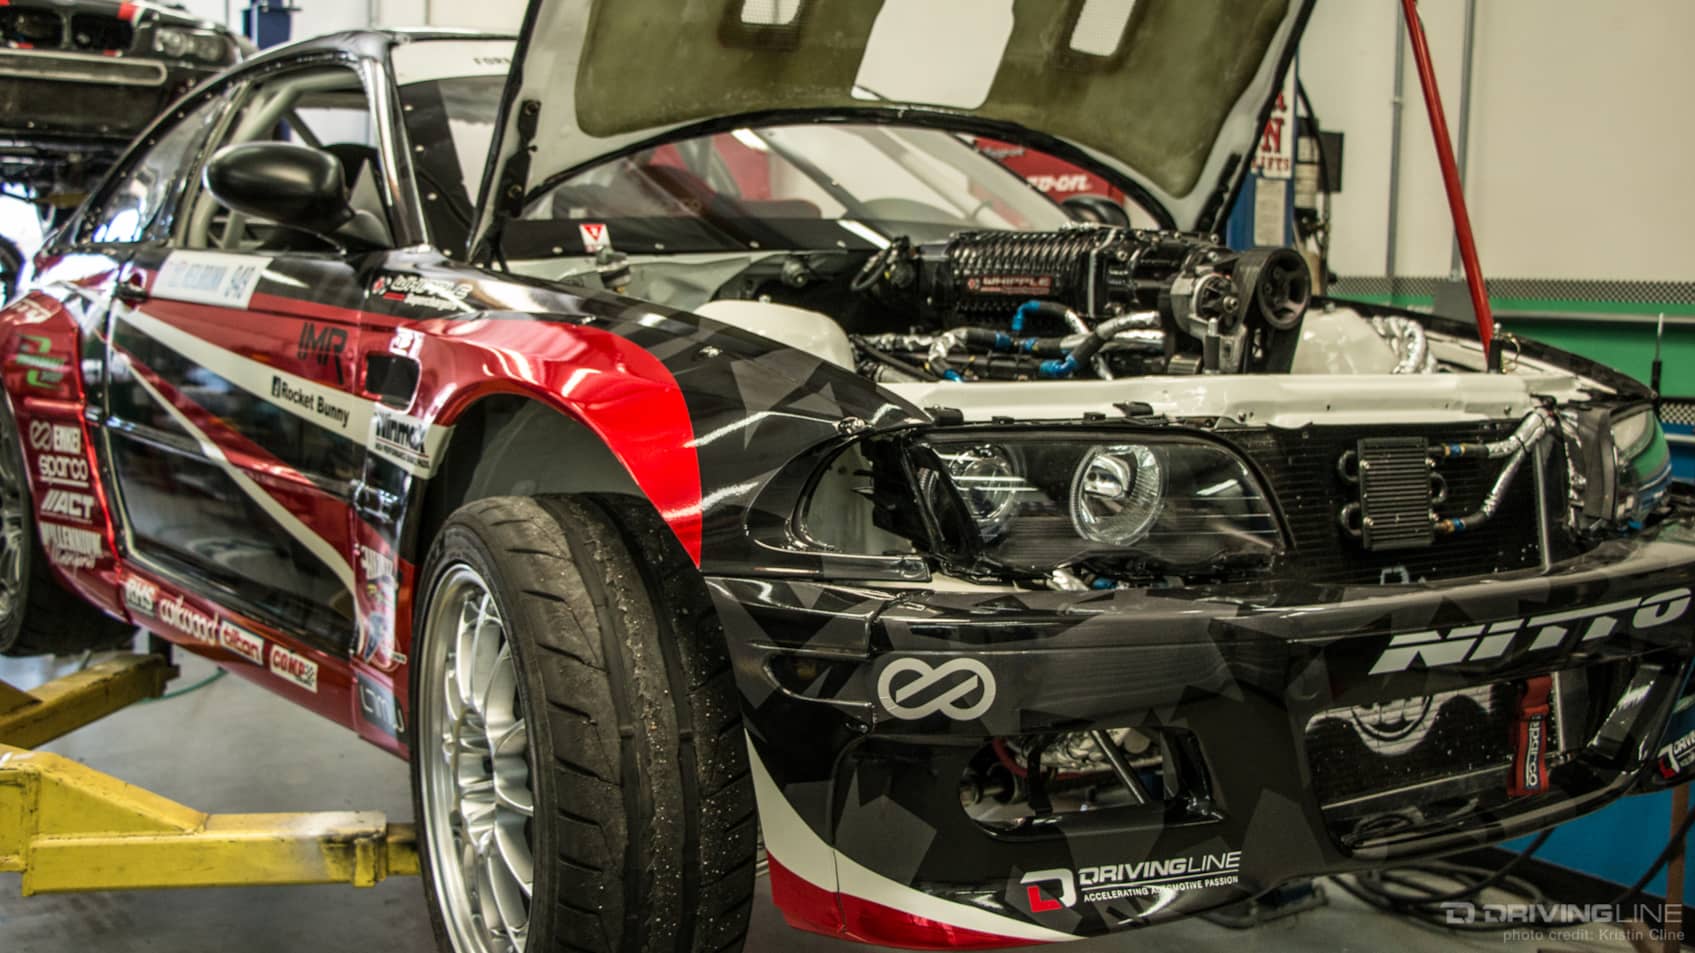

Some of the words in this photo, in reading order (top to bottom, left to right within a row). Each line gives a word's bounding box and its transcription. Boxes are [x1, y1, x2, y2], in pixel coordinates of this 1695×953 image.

[281, 379, 315, 413] Rocket
[316, 395, 350, 428] Bunny
[39, 454, 89, 486] sparco
[1083, 887, 1149, 903] ACCELERATING
[1151, 881, 1203, 895] AUOMOTIVE
[1205, 876, 1239, 889] PASSION
